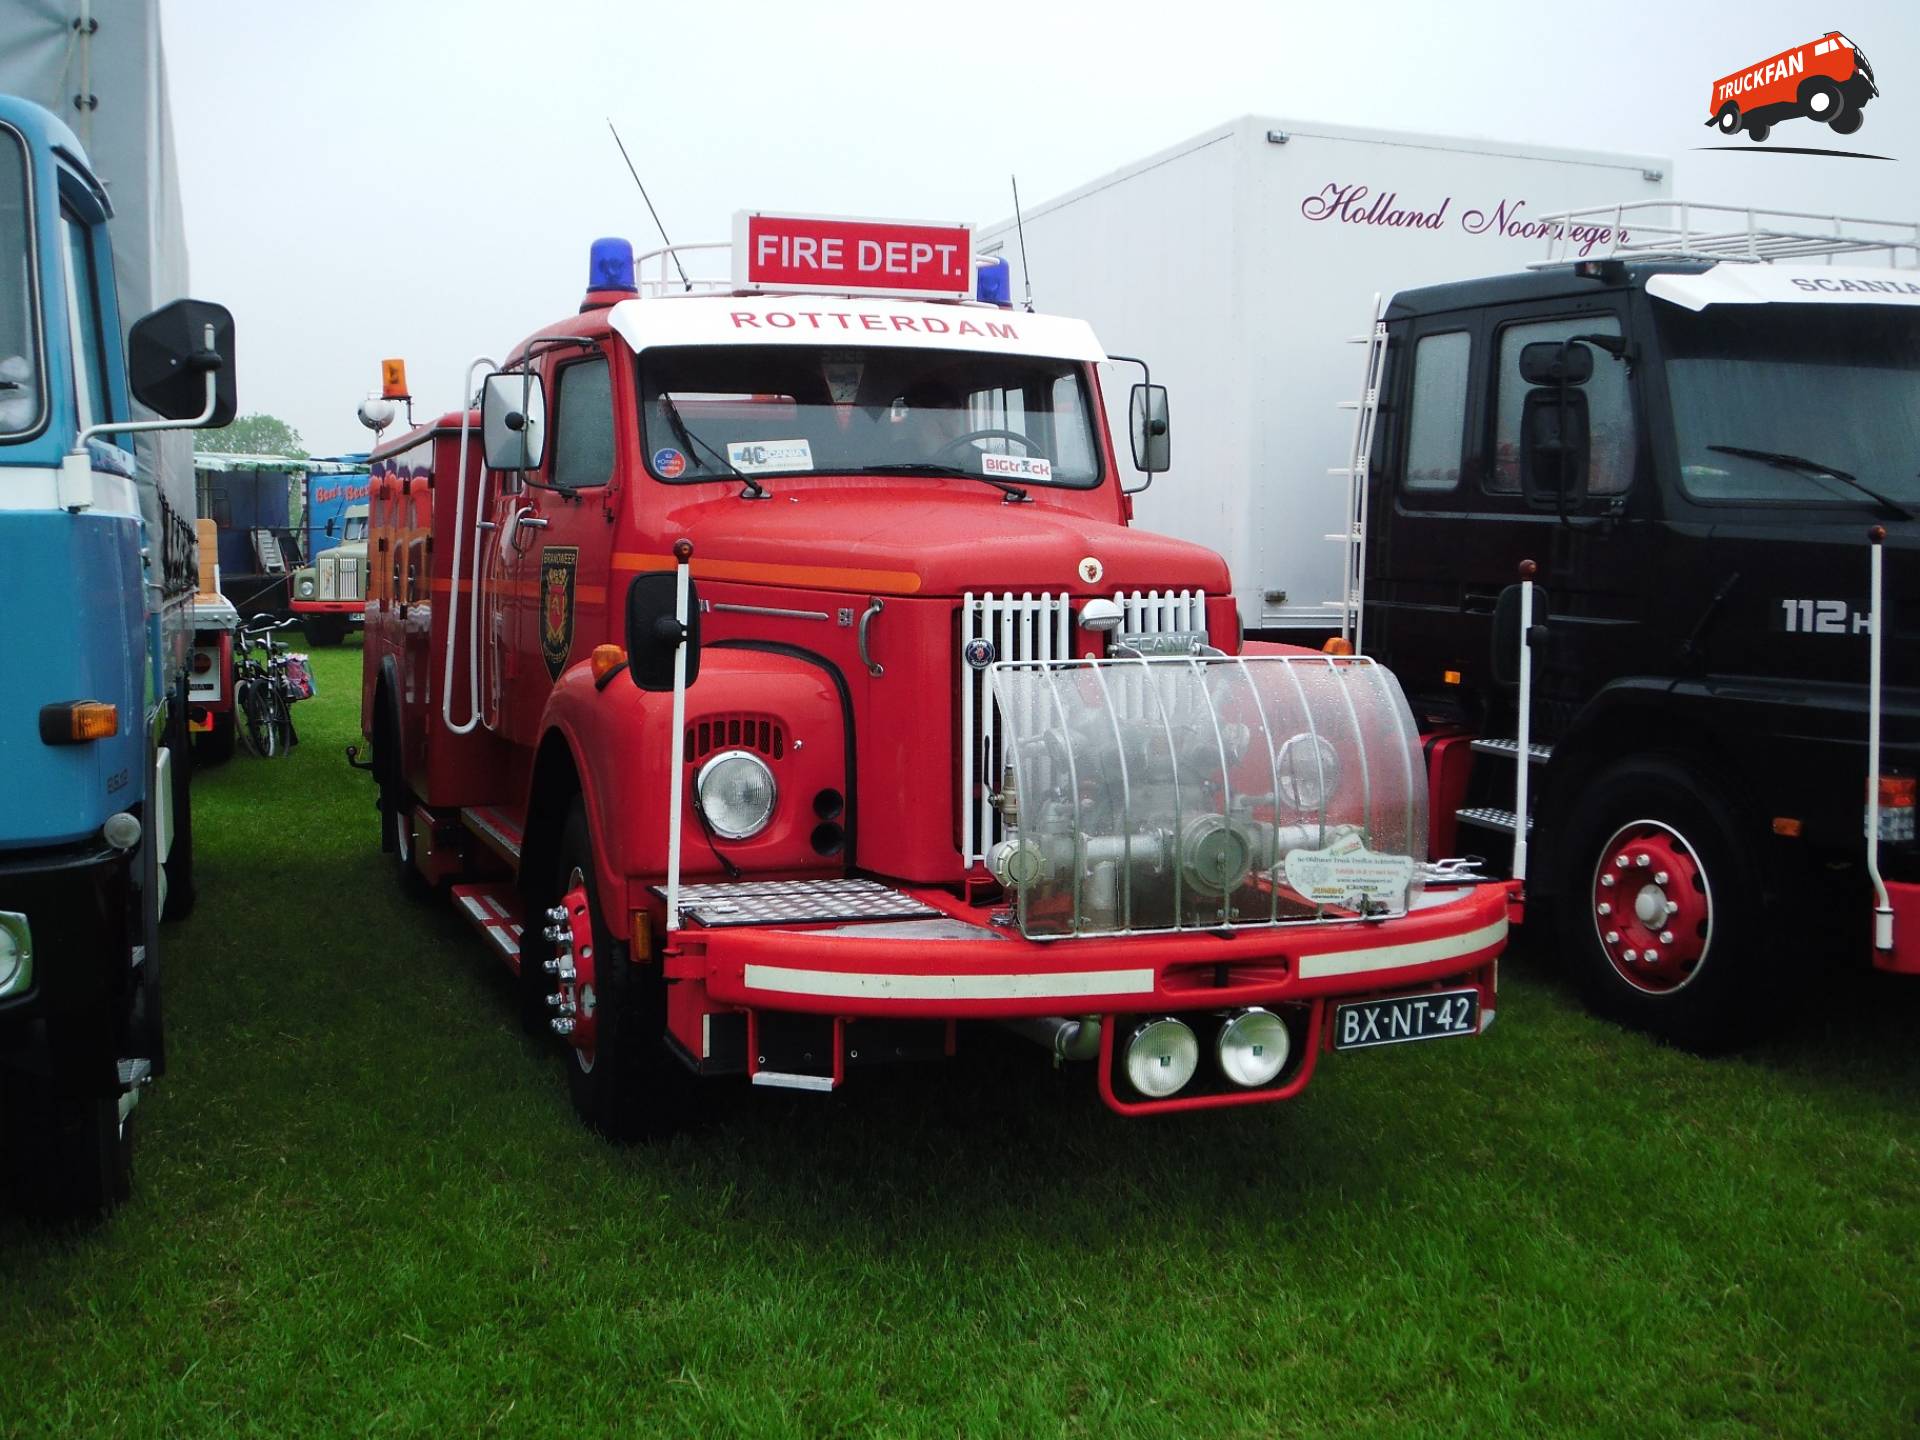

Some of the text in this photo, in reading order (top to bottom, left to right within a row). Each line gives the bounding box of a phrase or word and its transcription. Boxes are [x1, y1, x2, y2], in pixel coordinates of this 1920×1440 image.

[1301, 182, 1451, 231] Holland
[757, 234, 962, 276] FIRE DEPT.
[730, 311, 1020, 339] ROTTERDAM
[1782, 599, 1872, 634] 112 H
